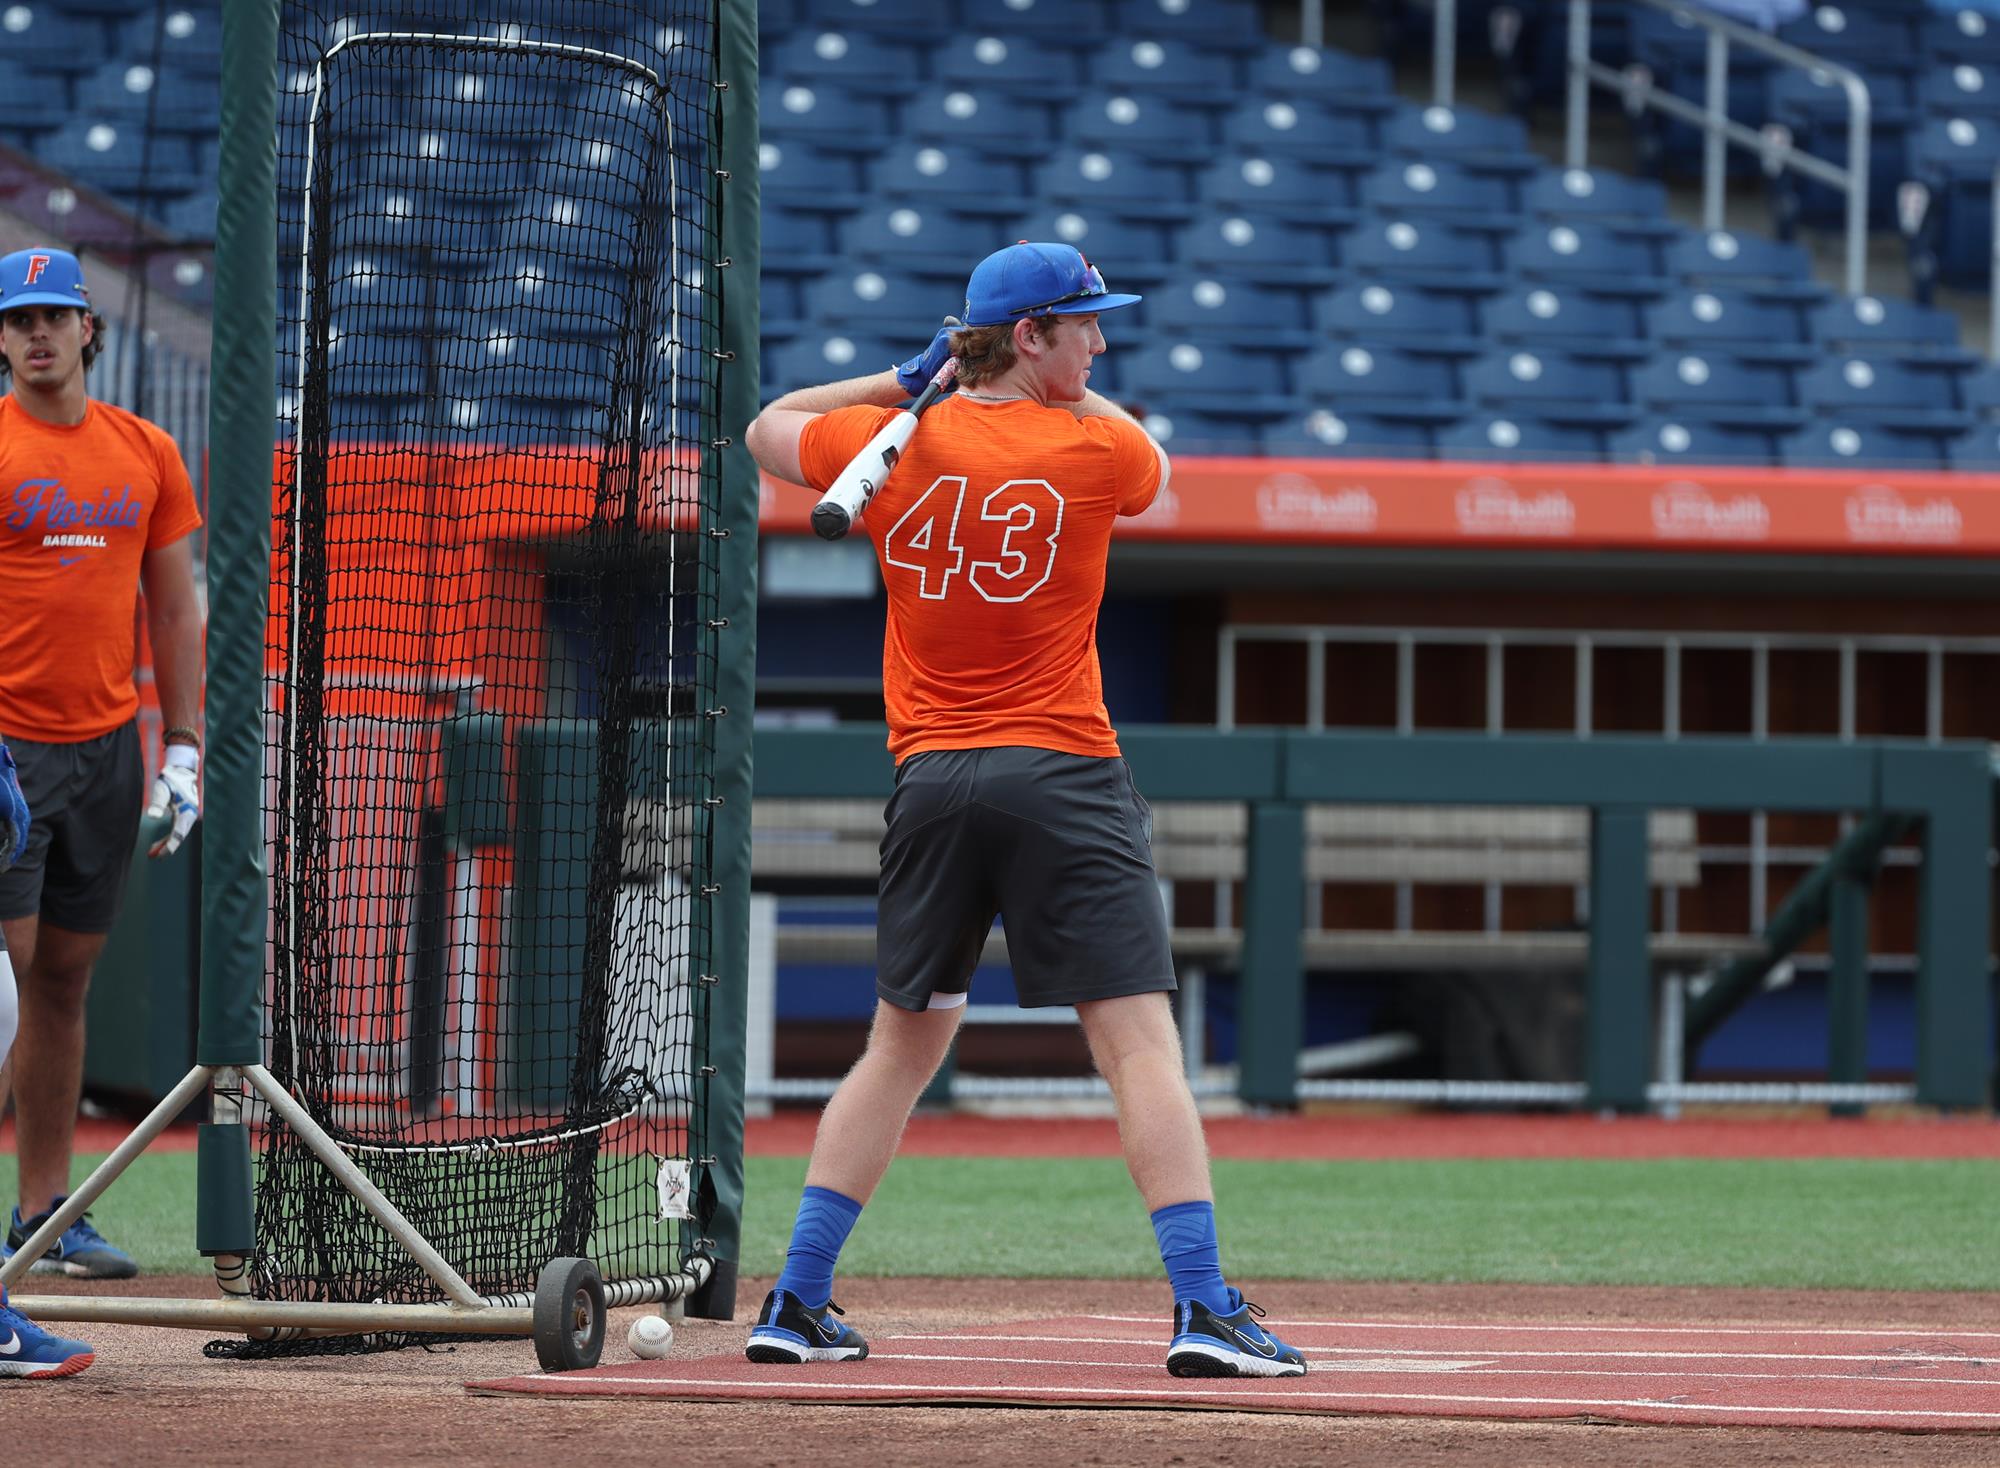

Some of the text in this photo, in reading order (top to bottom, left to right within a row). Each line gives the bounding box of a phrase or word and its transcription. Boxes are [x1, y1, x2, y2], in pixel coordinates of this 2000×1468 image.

[24, 255, 50, 286] F
[6, 478, 142, 532] Florida
[42, 534, 107, 547] BASEBALL
[885, 474, 1064, 603] 43
